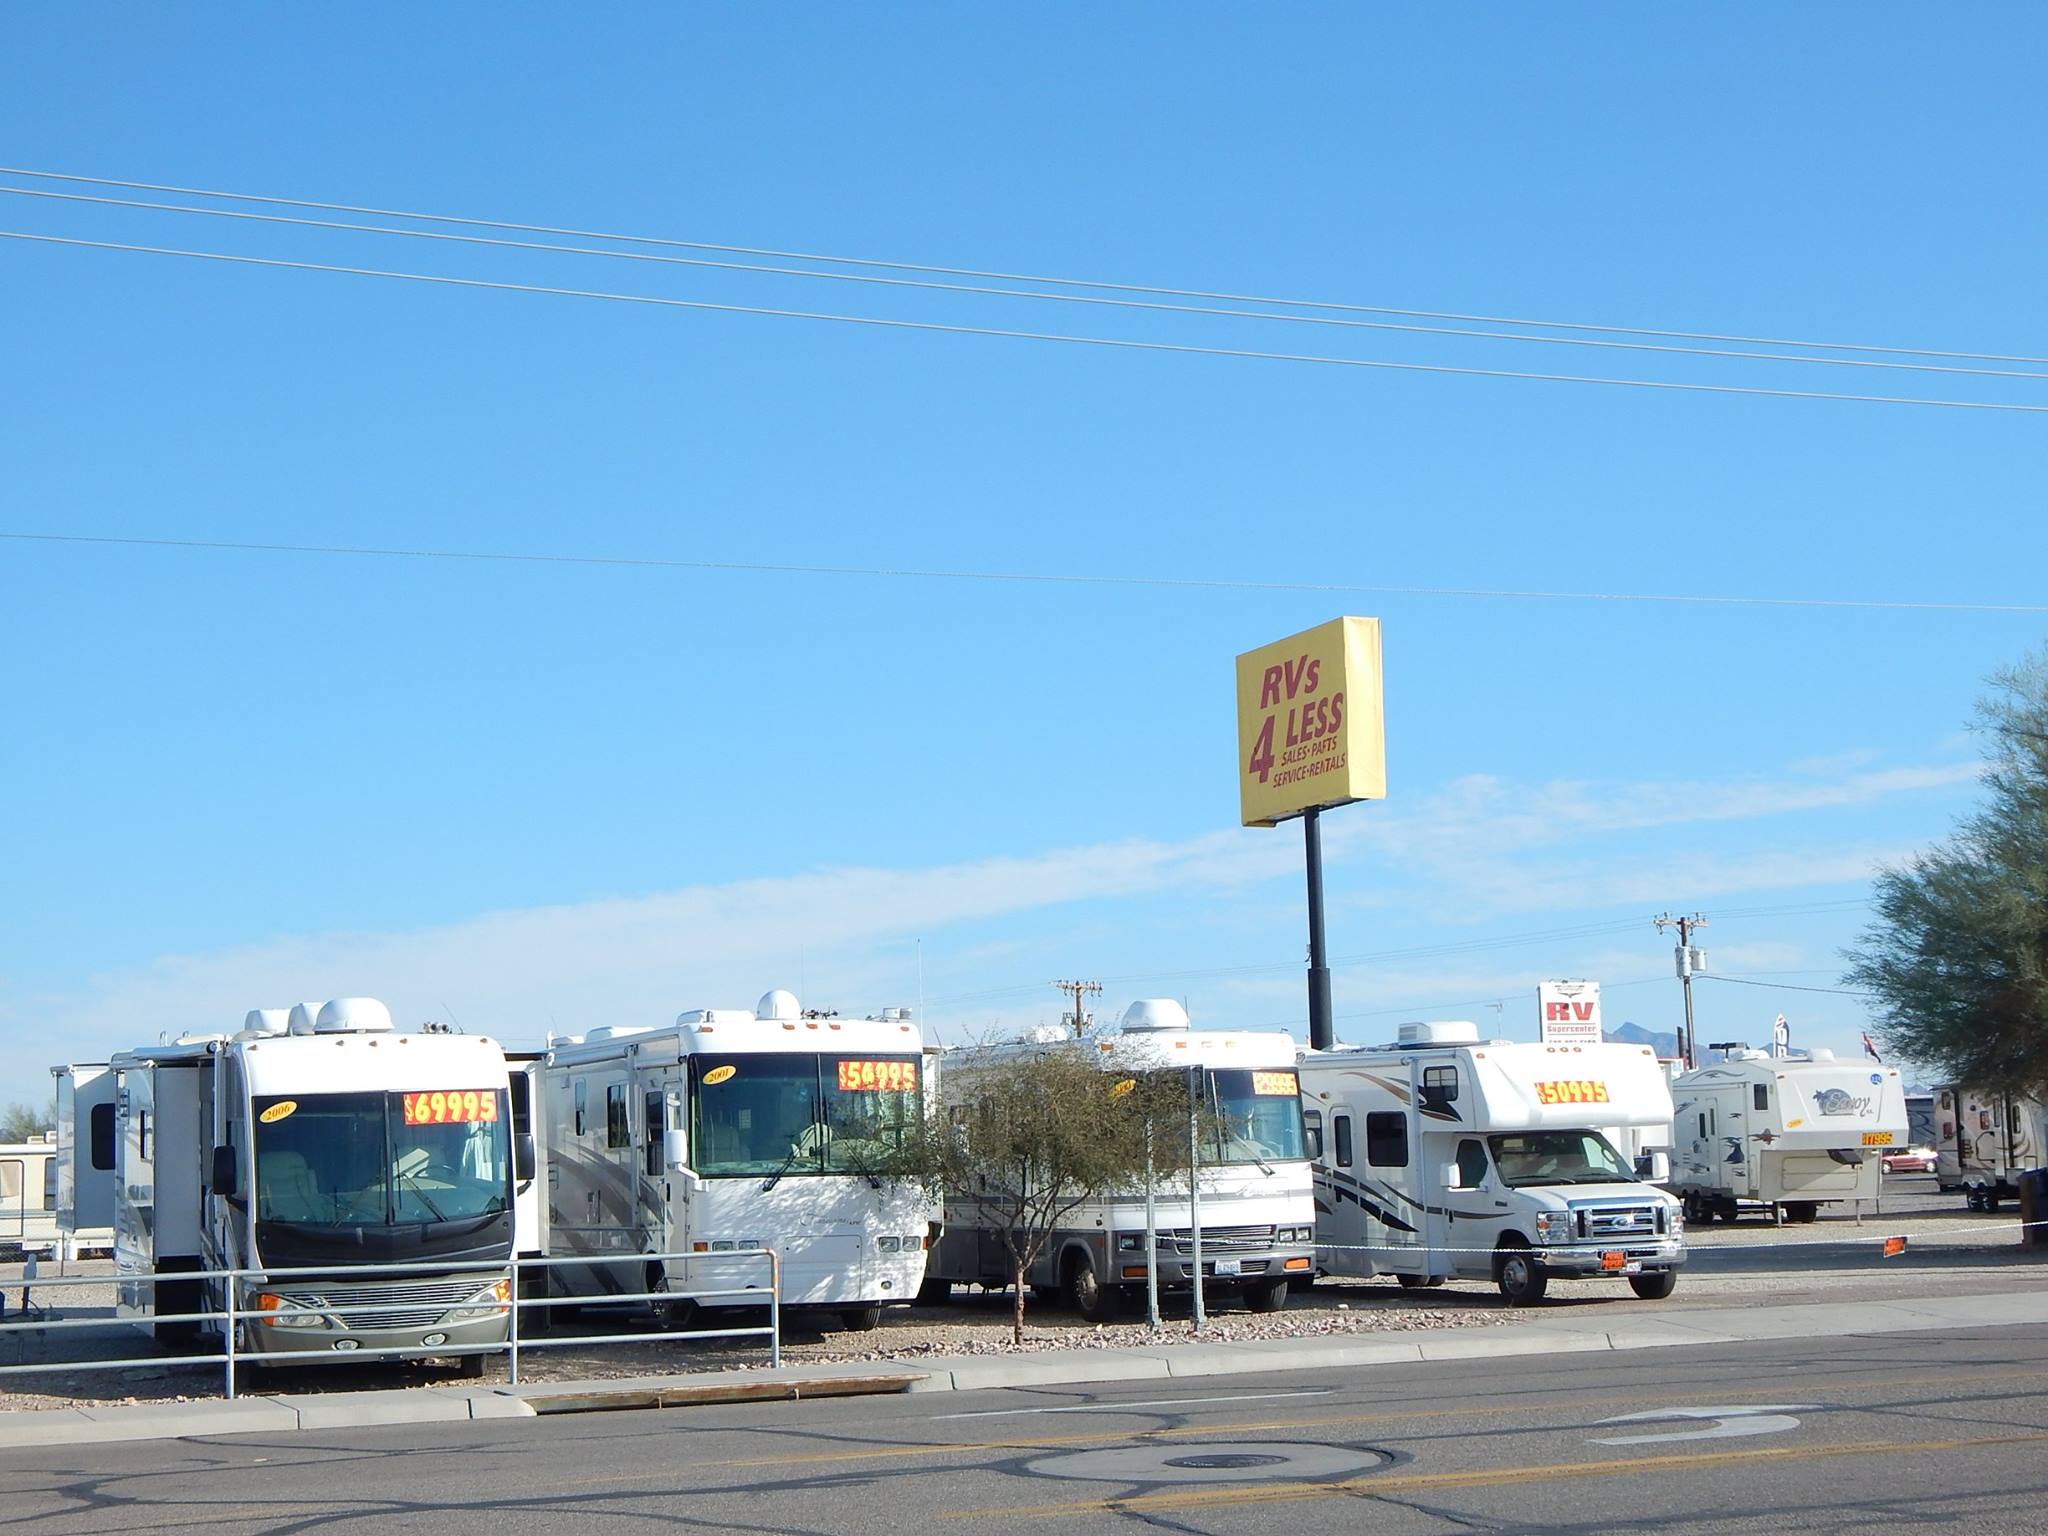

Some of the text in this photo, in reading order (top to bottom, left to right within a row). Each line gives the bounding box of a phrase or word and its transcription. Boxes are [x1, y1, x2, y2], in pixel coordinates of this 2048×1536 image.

[1260, 655, 1320, 709] RVs
[1249, 692, 1344, 783] 4 LESS
[1546, 1002, 1594, 1021] RV
[1547, 1025, 1597, 1033] Supercenter
[708, 1068, 730, 1084] 2001
[1535, 1081, 1609, 1104] $50995
[266, 1102, 291, 1121] 2006
[405, 1091, 497, 1123] $69995
